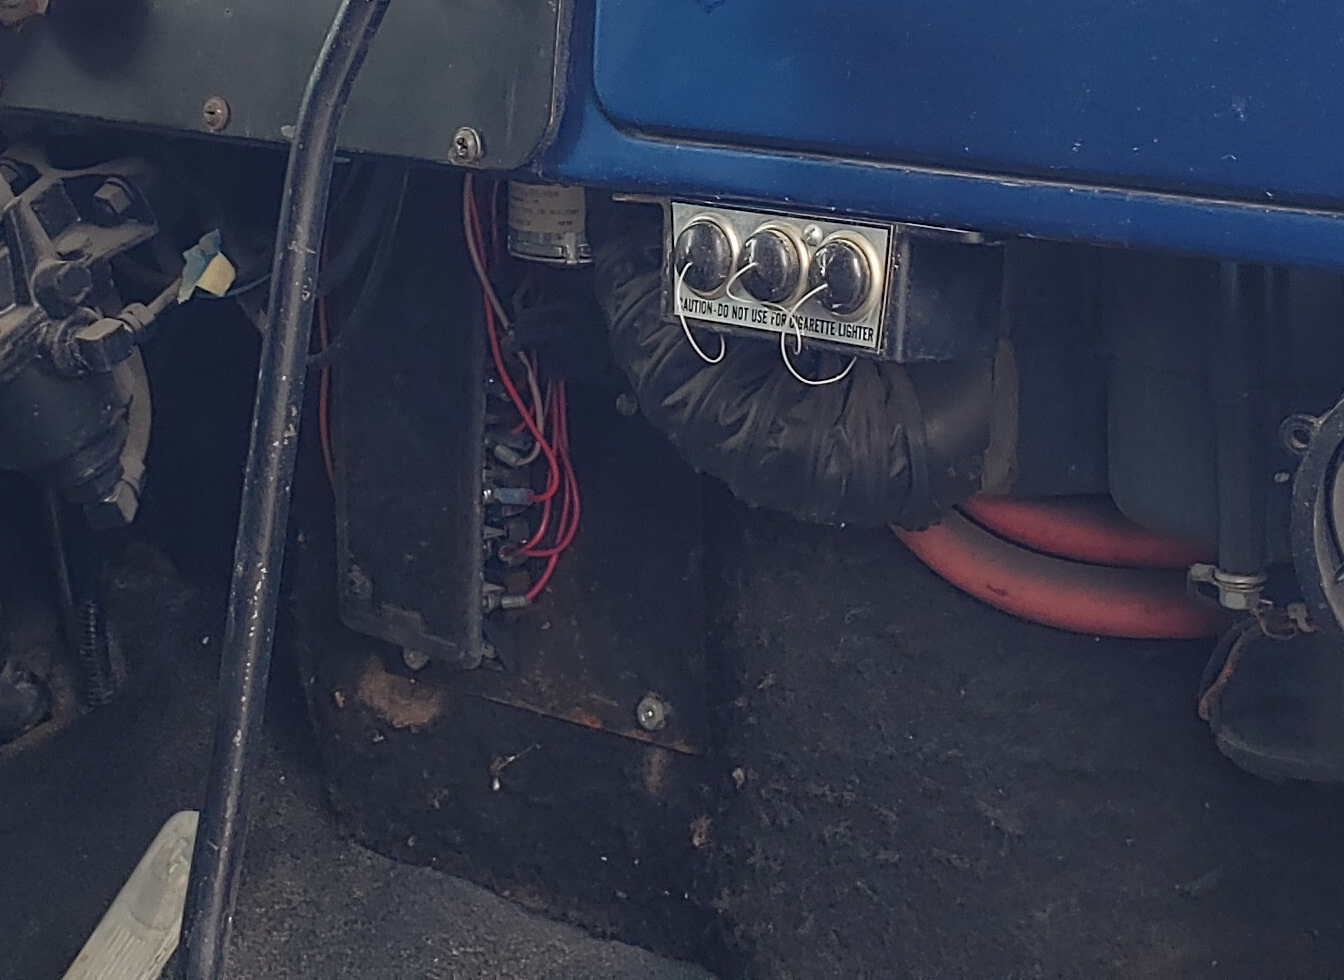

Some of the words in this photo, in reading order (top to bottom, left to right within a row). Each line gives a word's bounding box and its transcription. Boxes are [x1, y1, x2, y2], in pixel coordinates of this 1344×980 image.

[731, 305, 749, 321] NOT
[751, 309, 768, 324] USE
[770, 311, 786, 327] FOR
[789, 314, 836, 337] CIGARETTE
[838, 320, 874, 343] LIGHTER
